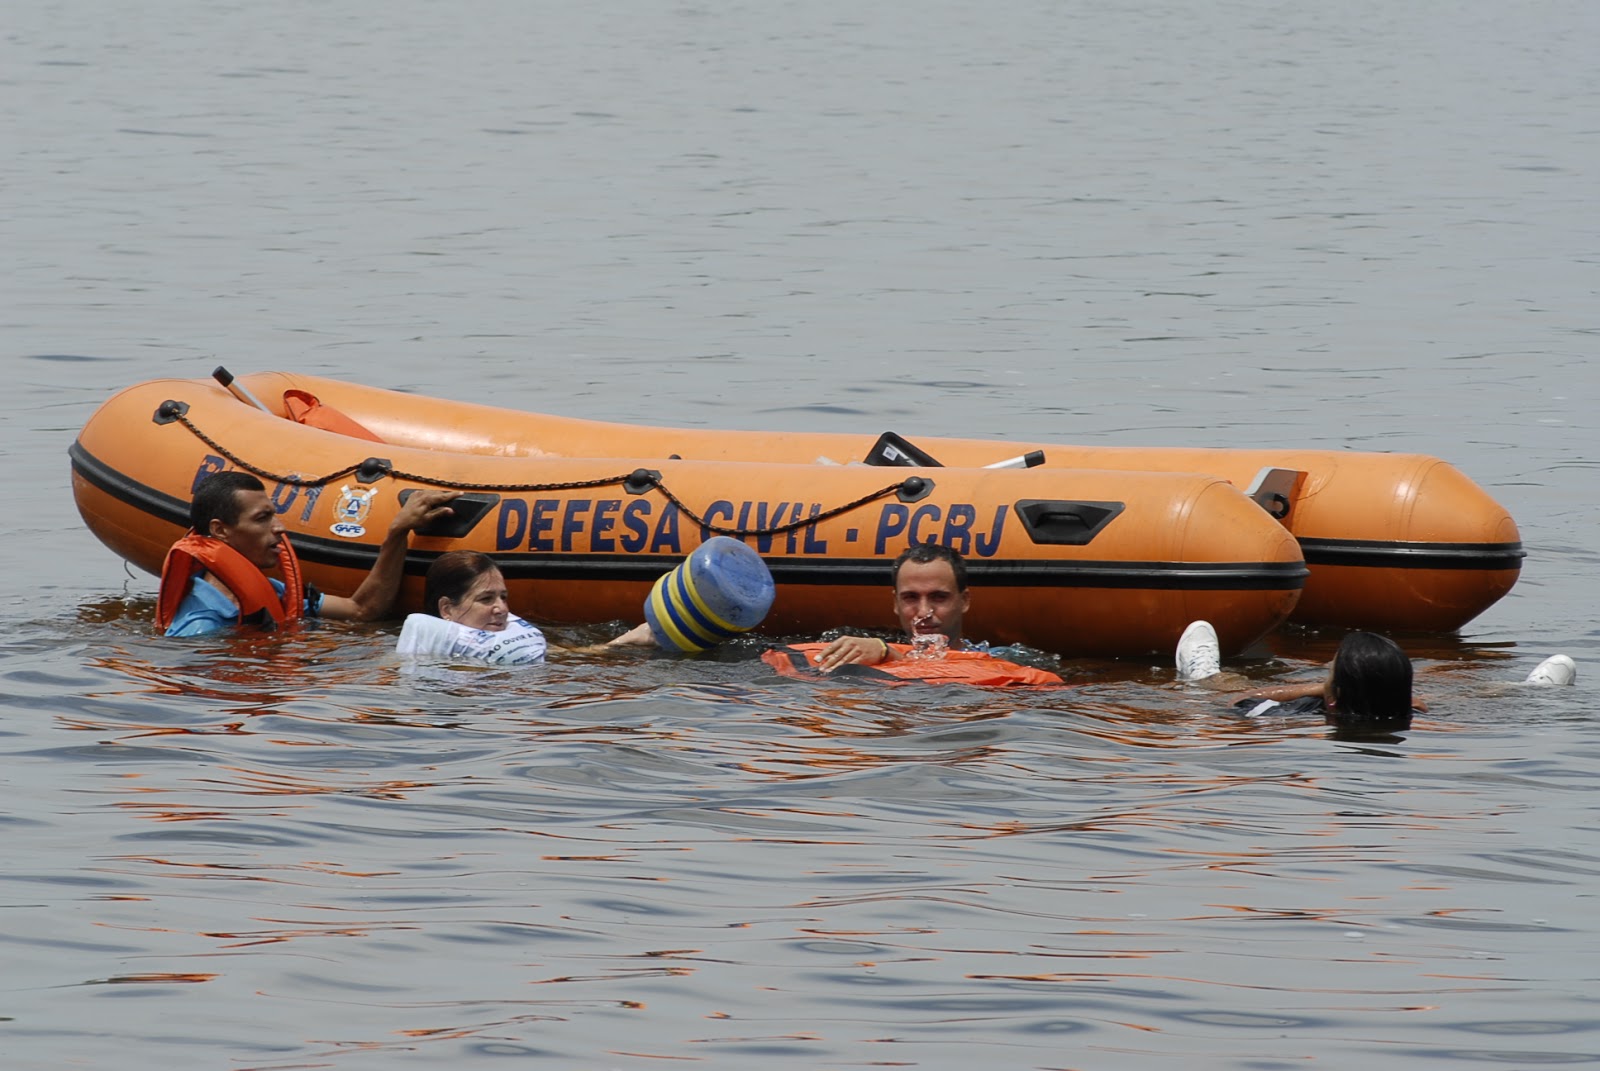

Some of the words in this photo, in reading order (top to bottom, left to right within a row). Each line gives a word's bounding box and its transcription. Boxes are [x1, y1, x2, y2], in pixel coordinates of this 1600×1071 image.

[496, 498, 681, 553] DEFESA
[700, 499, 828, 554] CIVIL
[874, 503, 1009, 557] PCRJ
